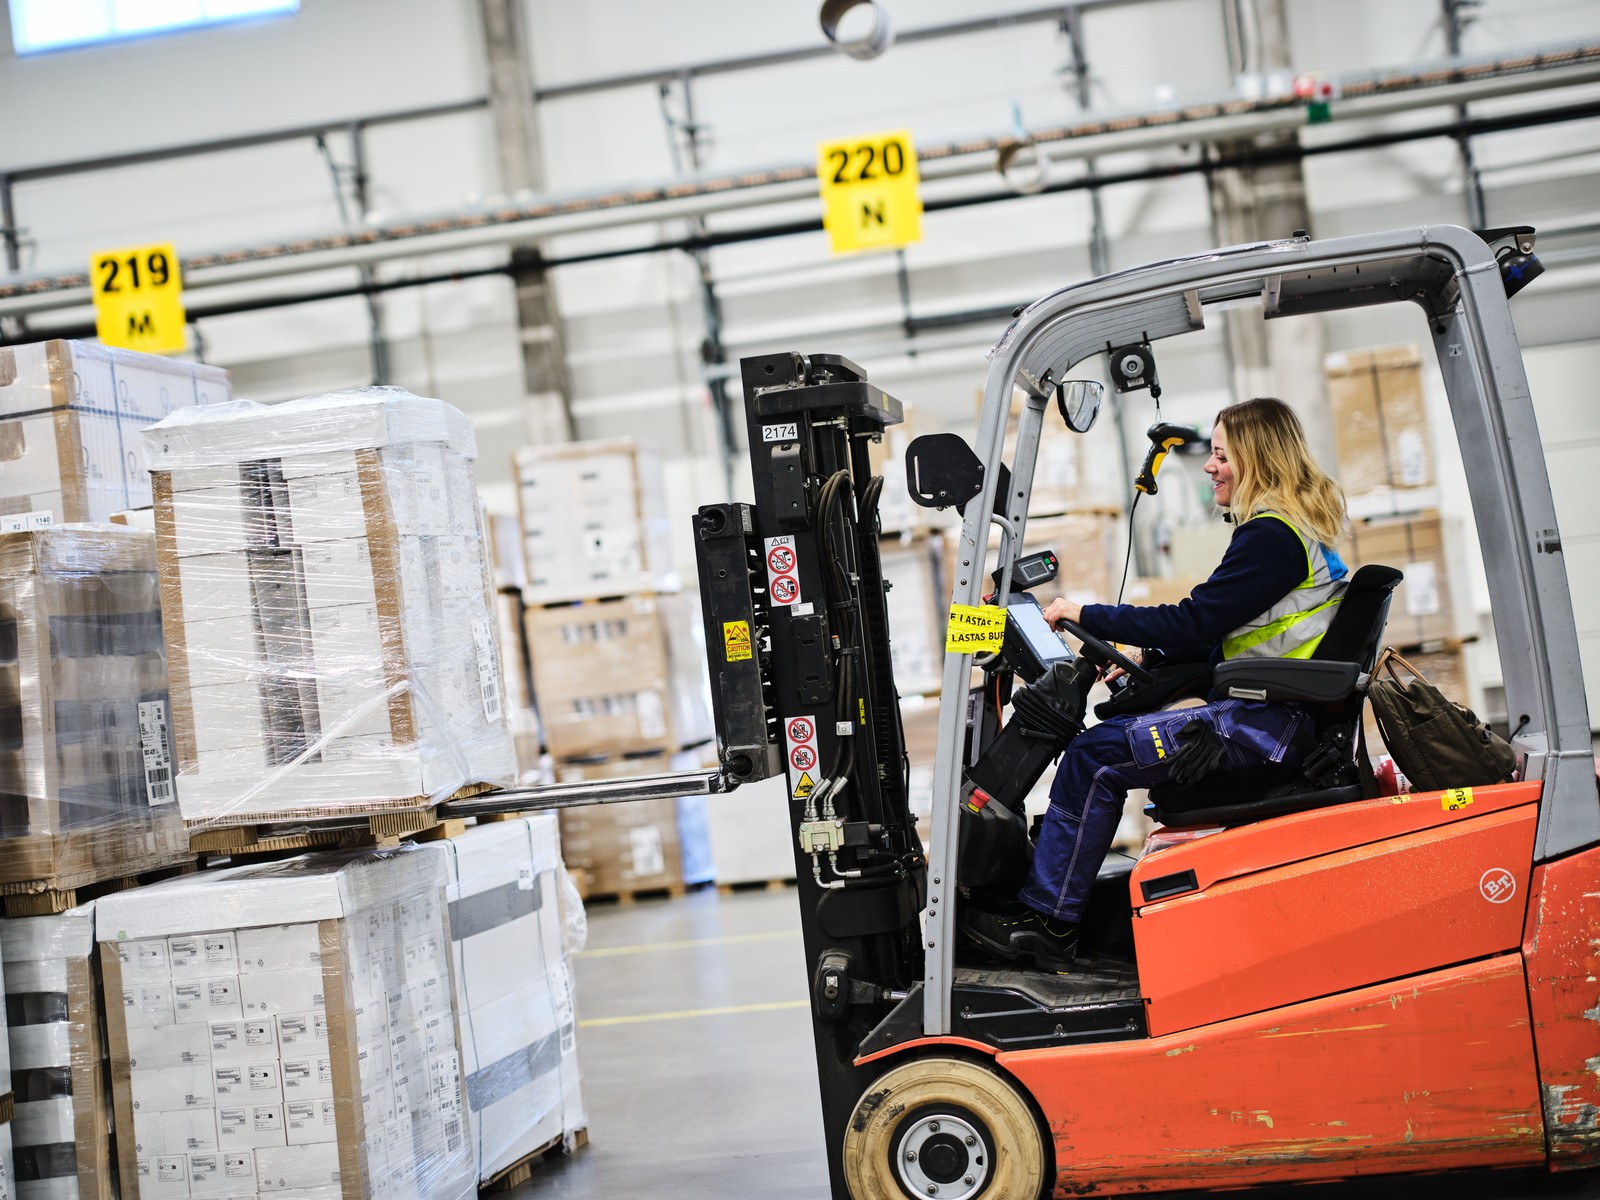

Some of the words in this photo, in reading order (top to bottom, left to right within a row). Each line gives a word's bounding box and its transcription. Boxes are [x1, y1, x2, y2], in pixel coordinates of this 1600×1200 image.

[830, 142, 904, 184] 220
[862, 202, 885, 229] N
[100, 252, 169, 293] 219
[127, 314, 156, 337] M
[764, 425, 796, 440] 2174
[35, 516, 51, 524] 1140
[951, 632, 986, 642] LASTAS
[1149, 725, 1166, 759] IKEA
[1484, 874, 1511, 896] BT
